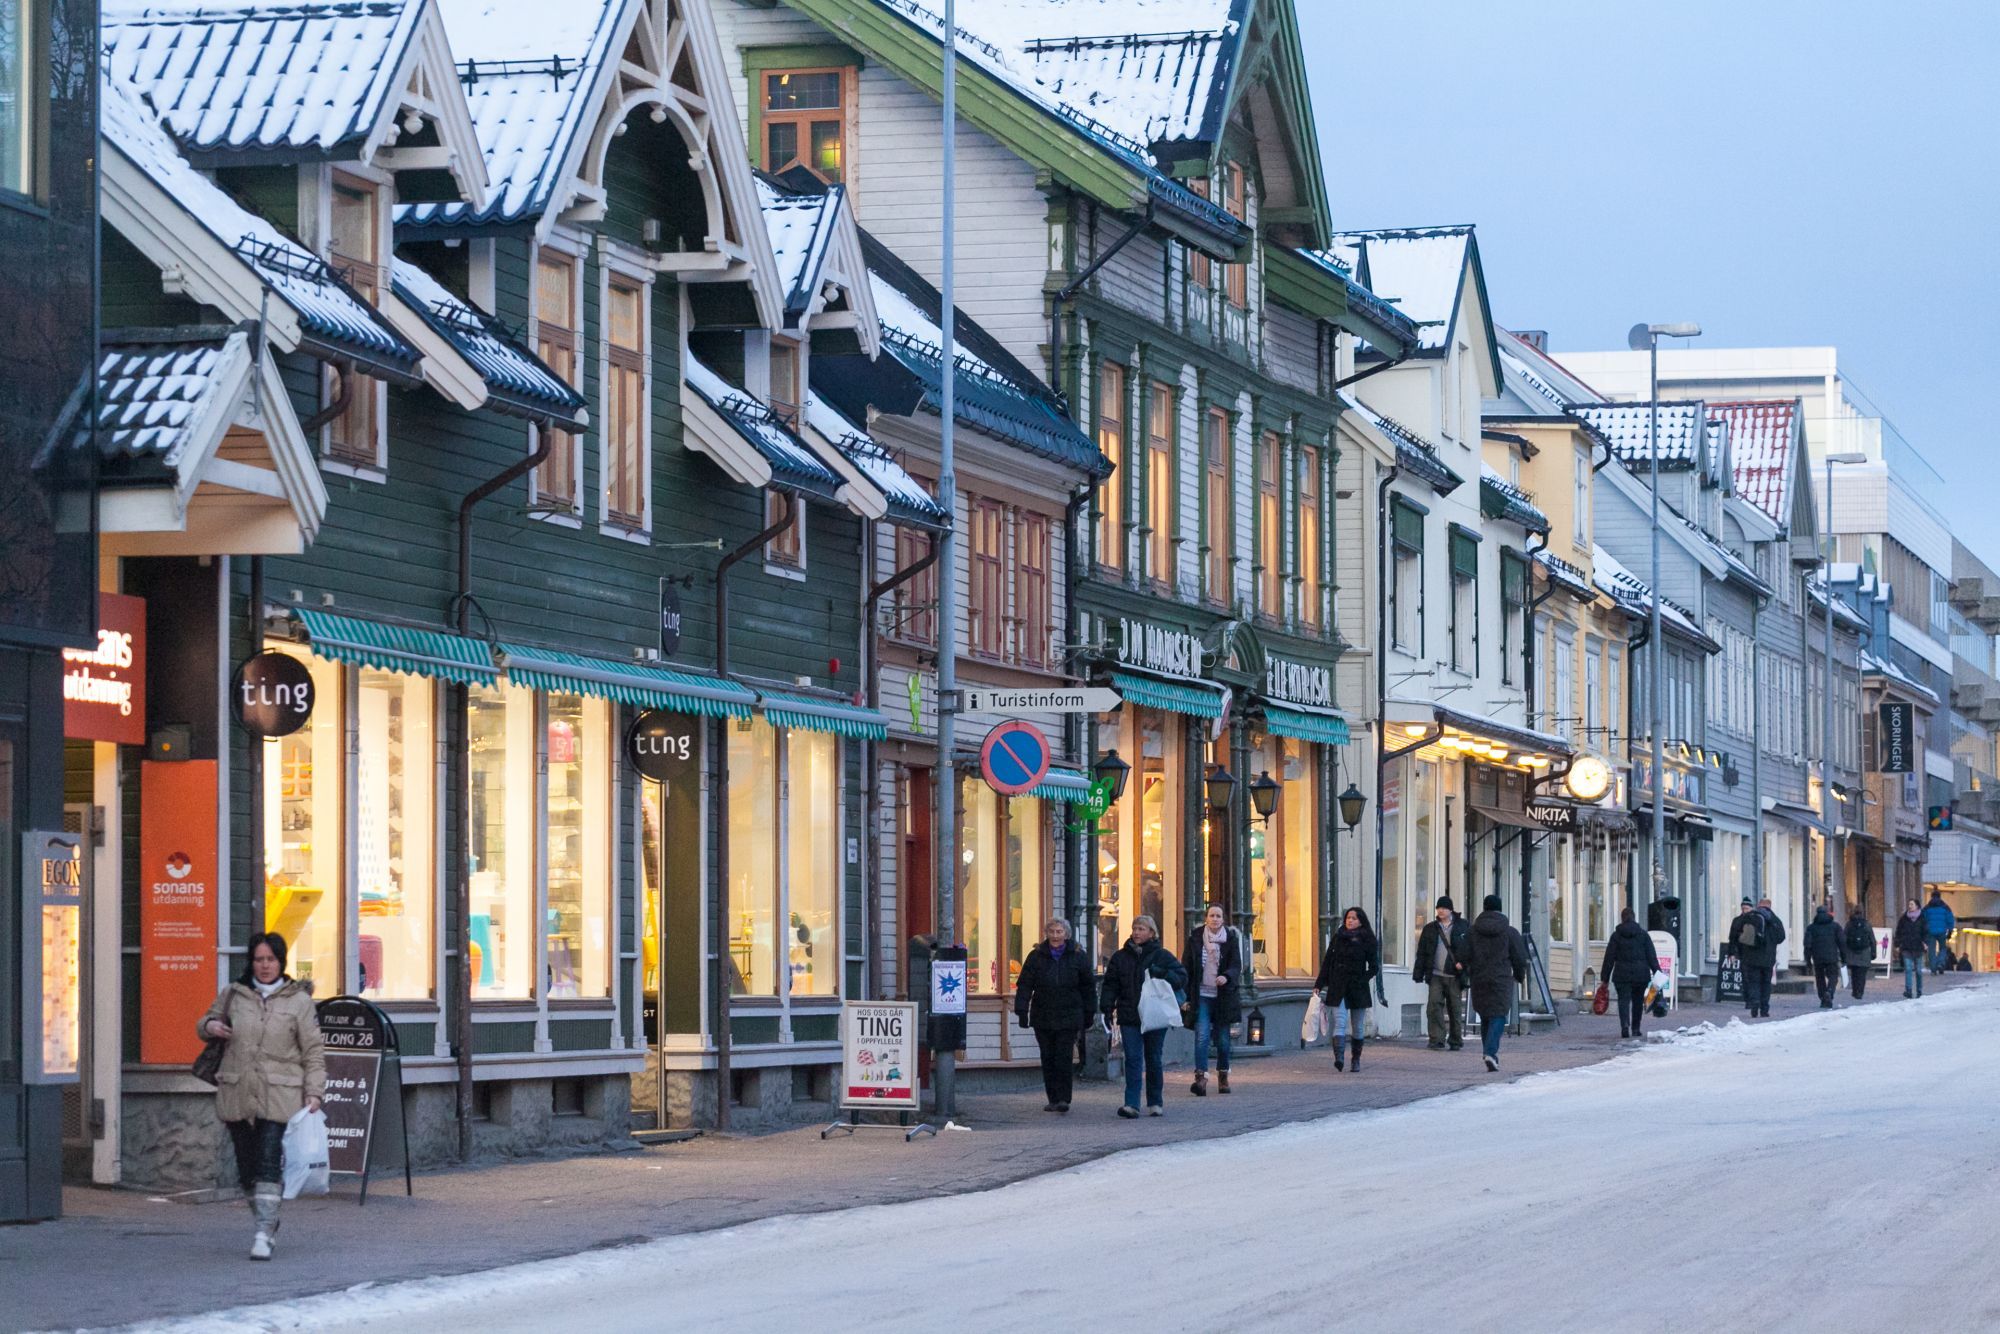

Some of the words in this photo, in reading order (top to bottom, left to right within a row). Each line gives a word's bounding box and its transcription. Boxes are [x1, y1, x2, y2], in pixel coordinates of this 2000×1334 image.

[663, 606, 680, 637] ting
[1146, 624, 1201, 678] HANSEN
[63, 667, 131, 716] utdanning
[1266, 656, 1331, 707] ELEKTRISK
[241, 676, 308, 713] ting
[989, 692, 1084, 707] Turistinform
[634, 732, 690, 760] ting
[1891, 706, 1902, 770] SKORINGEN
[1526, 805, 1570, 823] NIKITA
[45, 860, 80, 885] EGON
[153, 882, 204, 894] sonans
[153, 895, 204, 907] utdanning
[889, 1007, 903, 1016] GÅR
[857, 1017, 902, 1037] TING
[357, 1033, 374, 1046] 28
[358, 1078, 366, 1089] å
